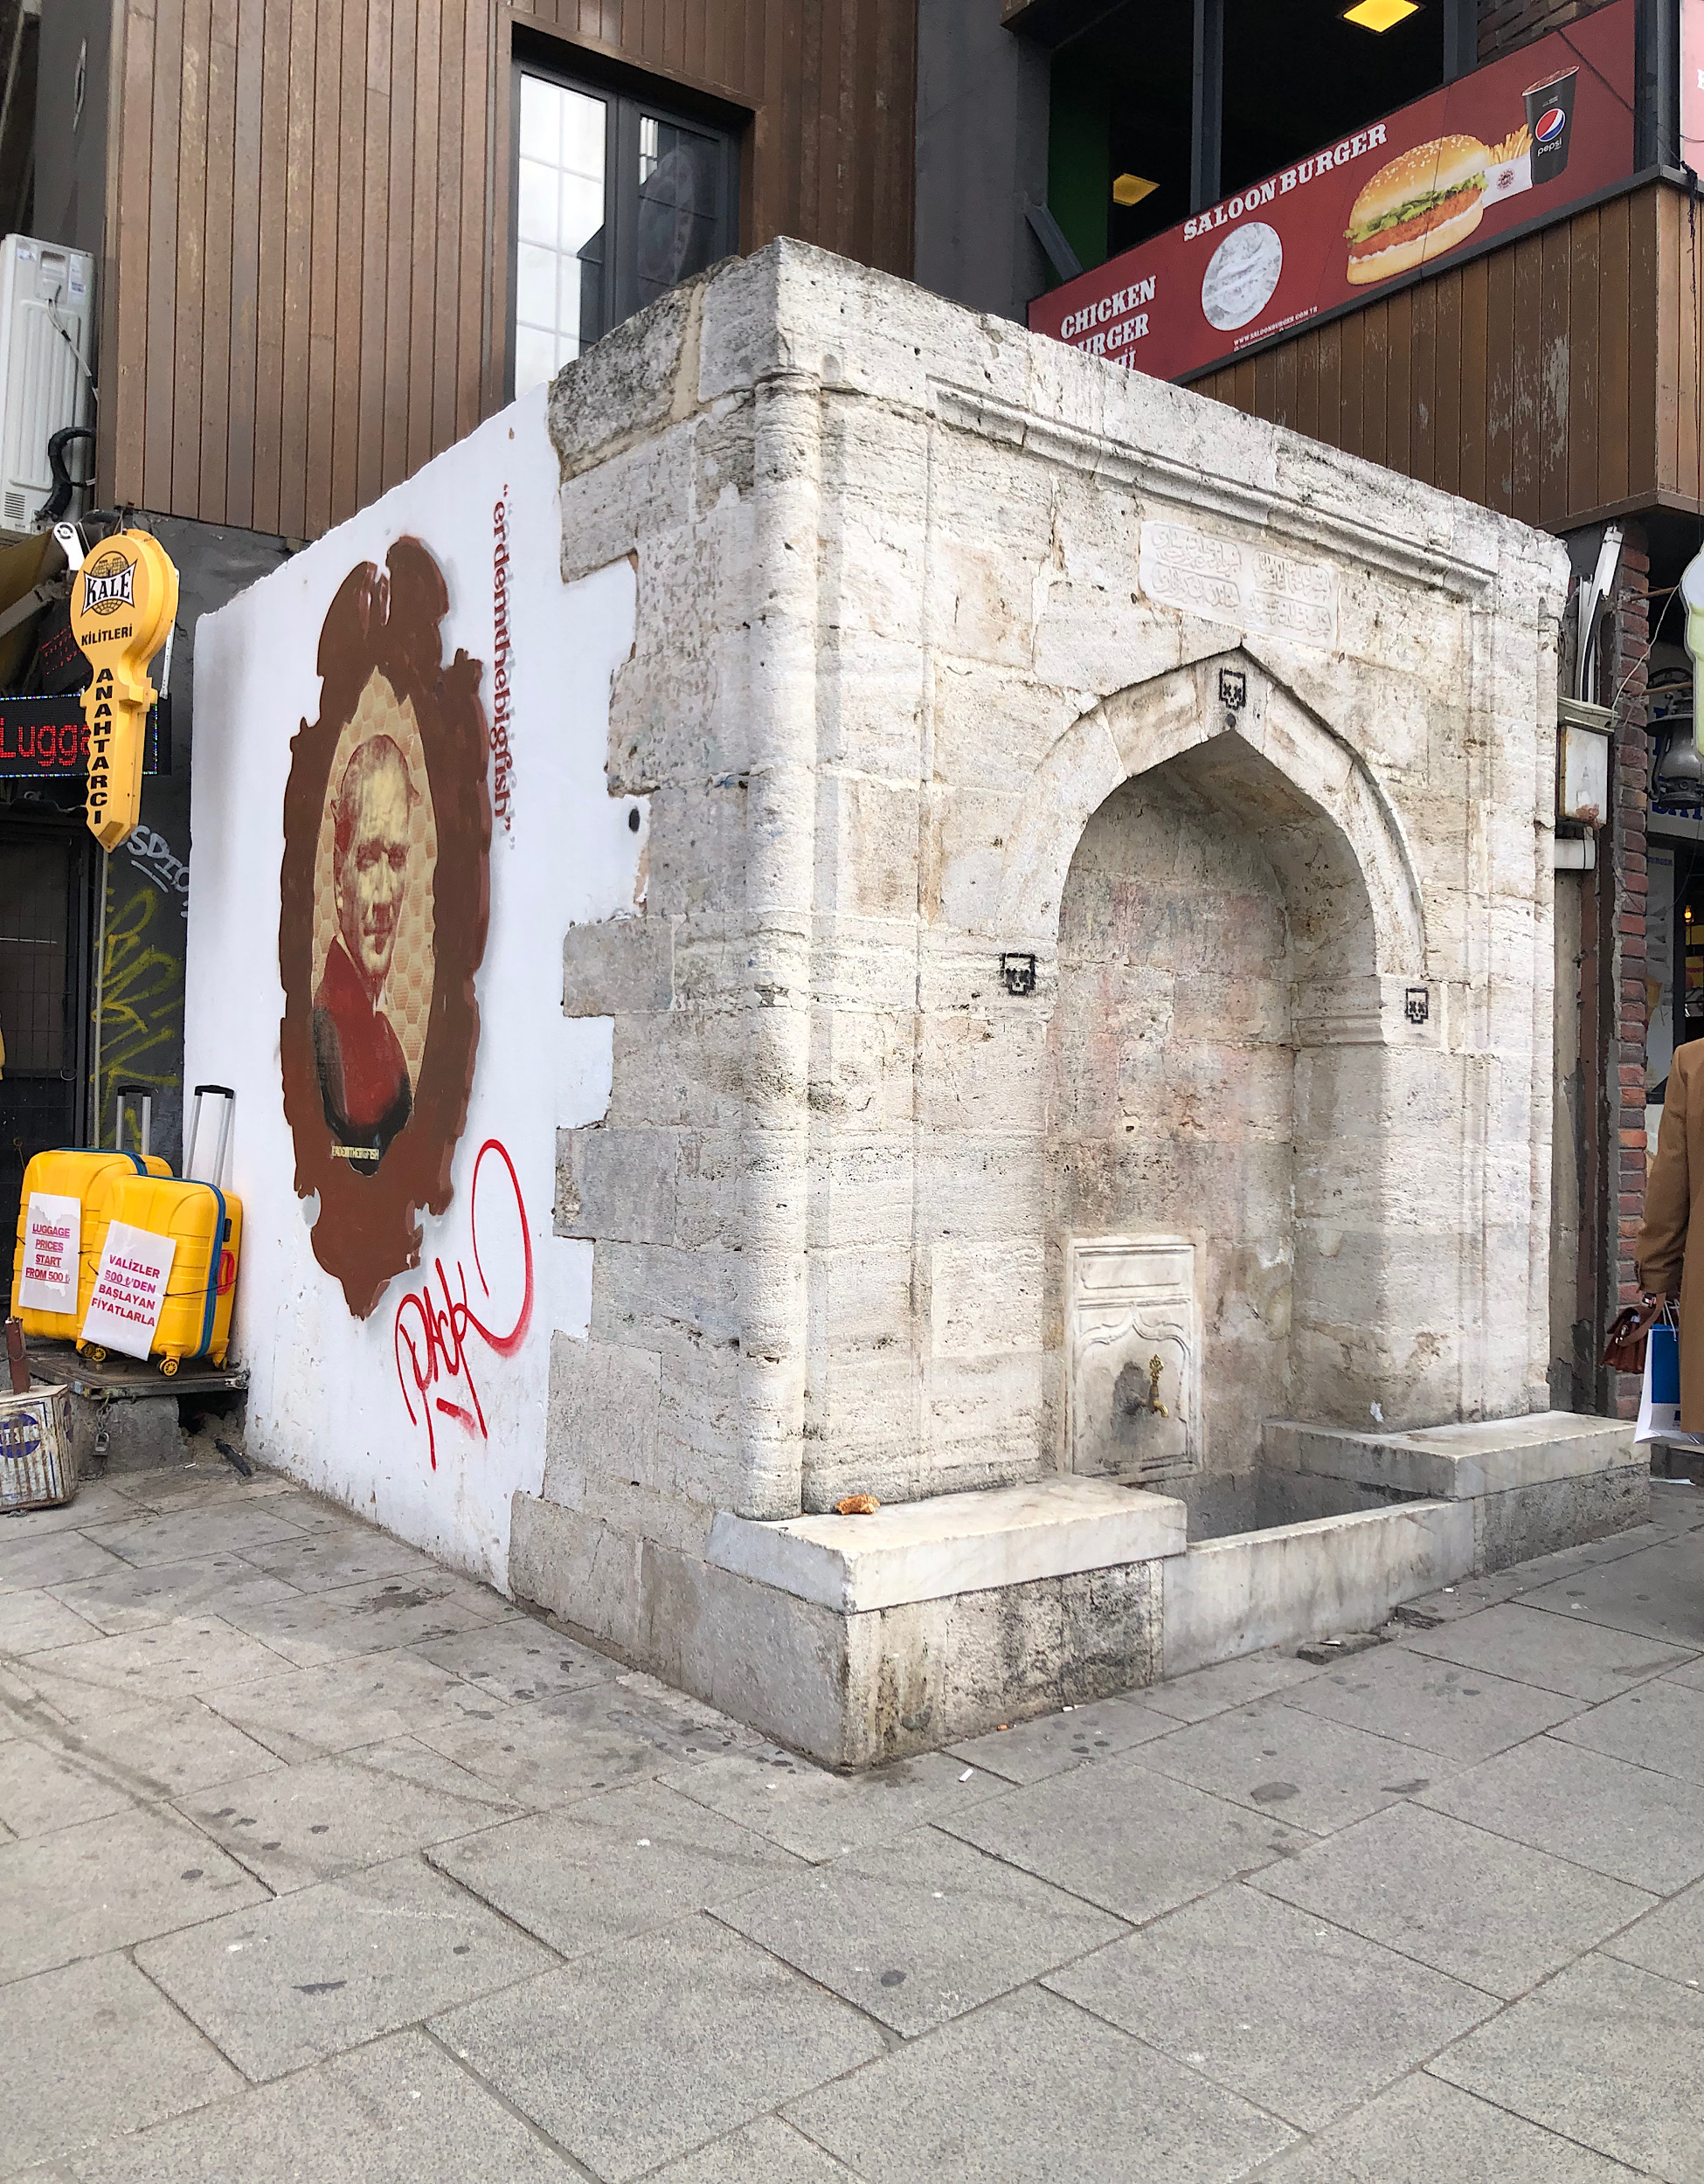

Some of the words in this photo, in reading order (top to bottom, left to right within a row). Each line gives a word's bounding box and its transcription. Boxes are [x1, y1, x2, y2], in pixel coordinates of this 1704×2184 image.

[1537, 137, 1562, 157] pepsi
[1183, 178, 1277, 242] SALOON
[1278, 122, 1388, 196] BURGER
[1060, 274, 1157, 340] CHICKEN
[86, 569, 132, 609] KALE
[80, 623, 133, 646] KİLİTLERİ
[89, 668, 114, 826] ANAHTARCI
[31, 1223, 71, 1240] LUGGAGE
[34, 1238, 64, 1254] PRICES
[35, 1254, 62, 1268] START
[108, 1254, 161, 1279] VALİZLER
[24, 1267, 47, 1282] FROM
[47, 1271, 64, 1282] 500
[104, 1268, 123, 1285] 500
[98, 1283, 156, 1310] BAŞLAYAN
[91, 1296, 156, 1327] FİYATLARLA
